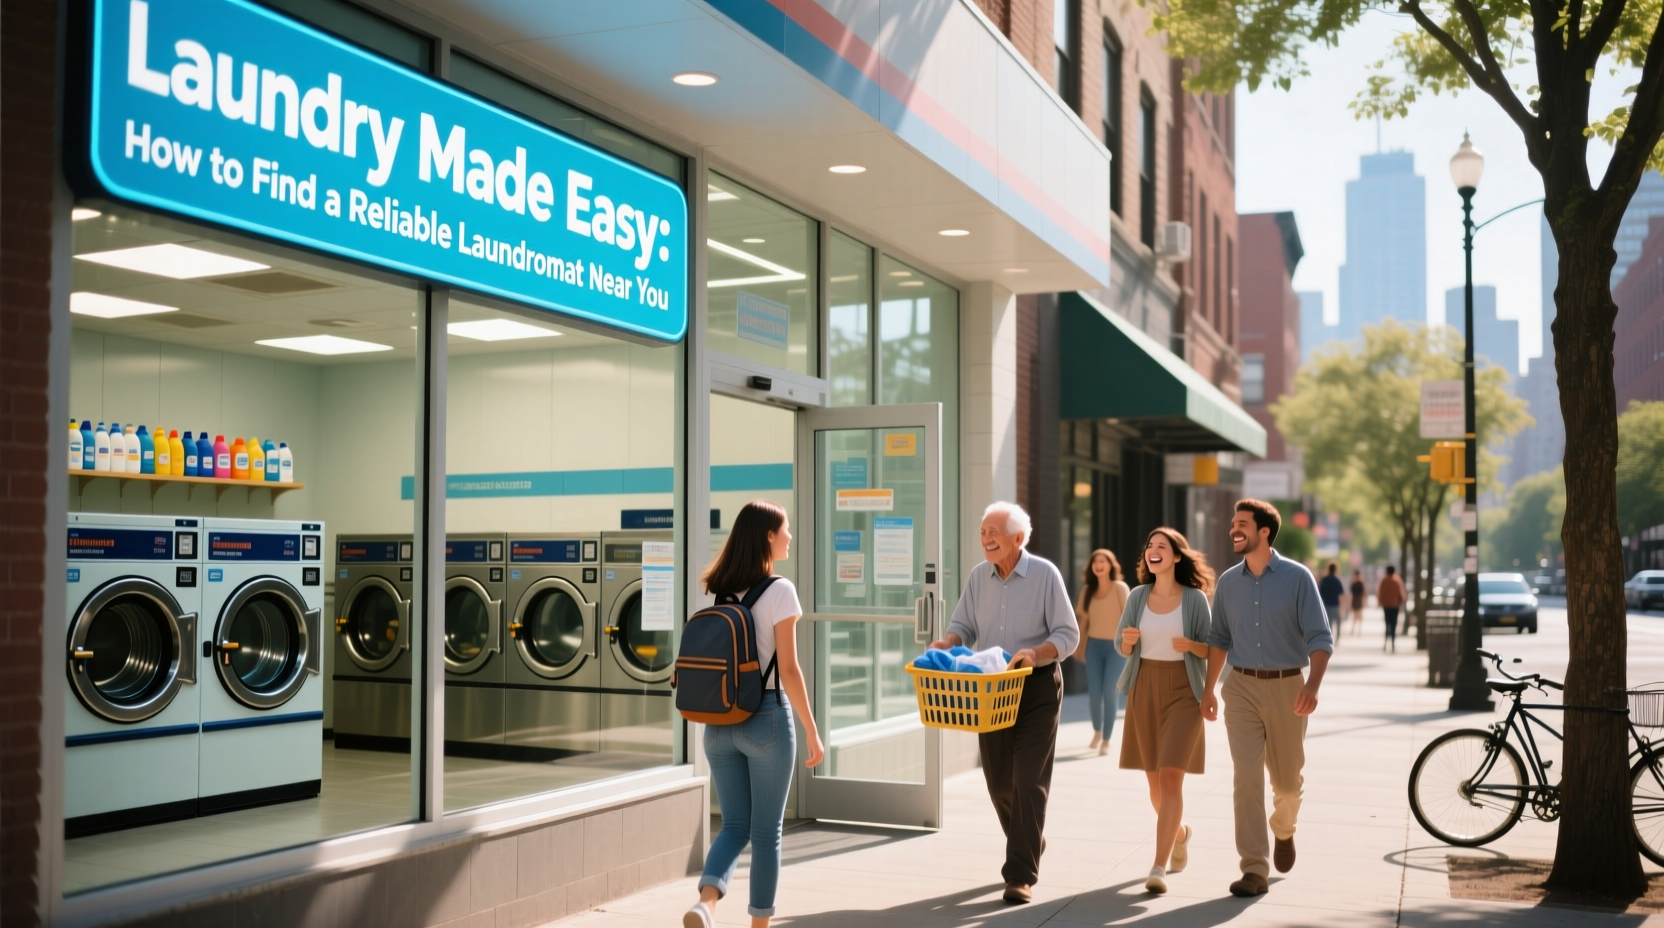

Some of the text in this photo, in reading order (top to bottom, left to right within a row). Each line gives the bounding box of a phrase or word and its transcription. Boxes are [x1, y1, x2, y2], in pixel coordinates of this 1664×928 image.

[125, 119, 669, 311] How to Find a Reliable Laundromat Near You
[127, 0, 671, 271] Laundry Made Easy:
